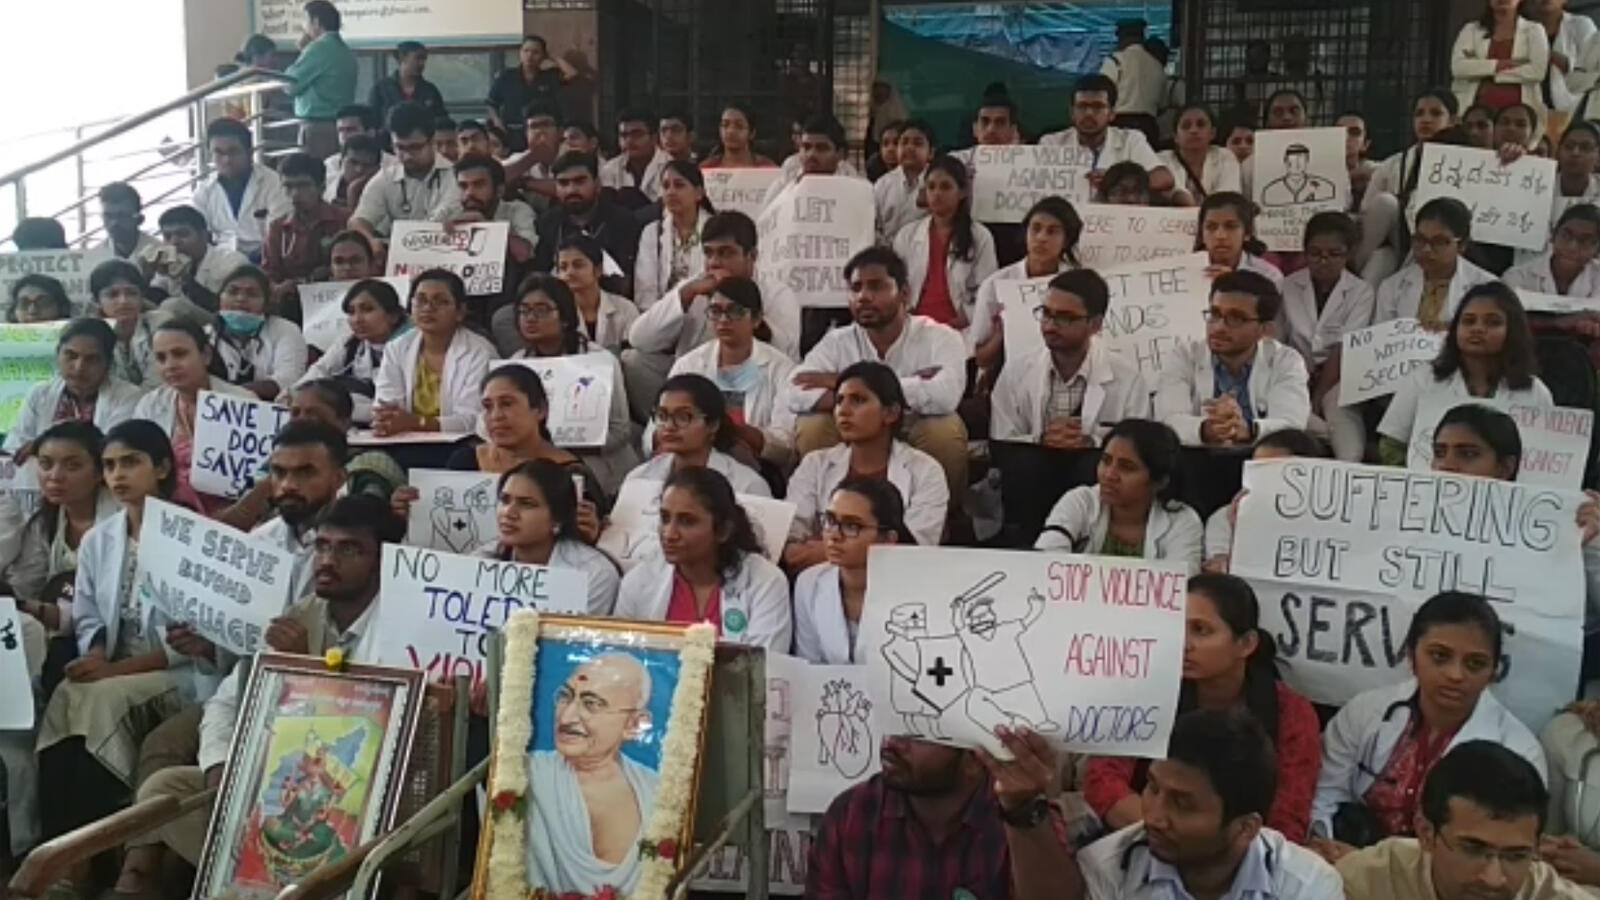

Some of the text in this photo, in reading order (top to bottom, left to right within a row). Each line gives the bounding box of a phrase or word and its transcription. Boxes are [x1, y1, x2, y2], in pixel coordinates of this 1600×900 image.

[1127, 217, 1145, 233] TO
[1350, 329, 1373, 349] NO
[202, 396, 258, 429] SAVE
[1275, 462, 1564, 552] SUFFERING
[160, 511, 280, 586] WE SERVE
[1274, 535, 1516, 604] BUT STILL
[177, 557, 252, 605] BEYOND
[393, 548, 550, 600] NO MORE
[1048, 561, 1186, 611] STOP VIOLENCE
[1064, 633, 1158, 680] AGAINST
[1063, 705, 1160, 743] DOCTORS
